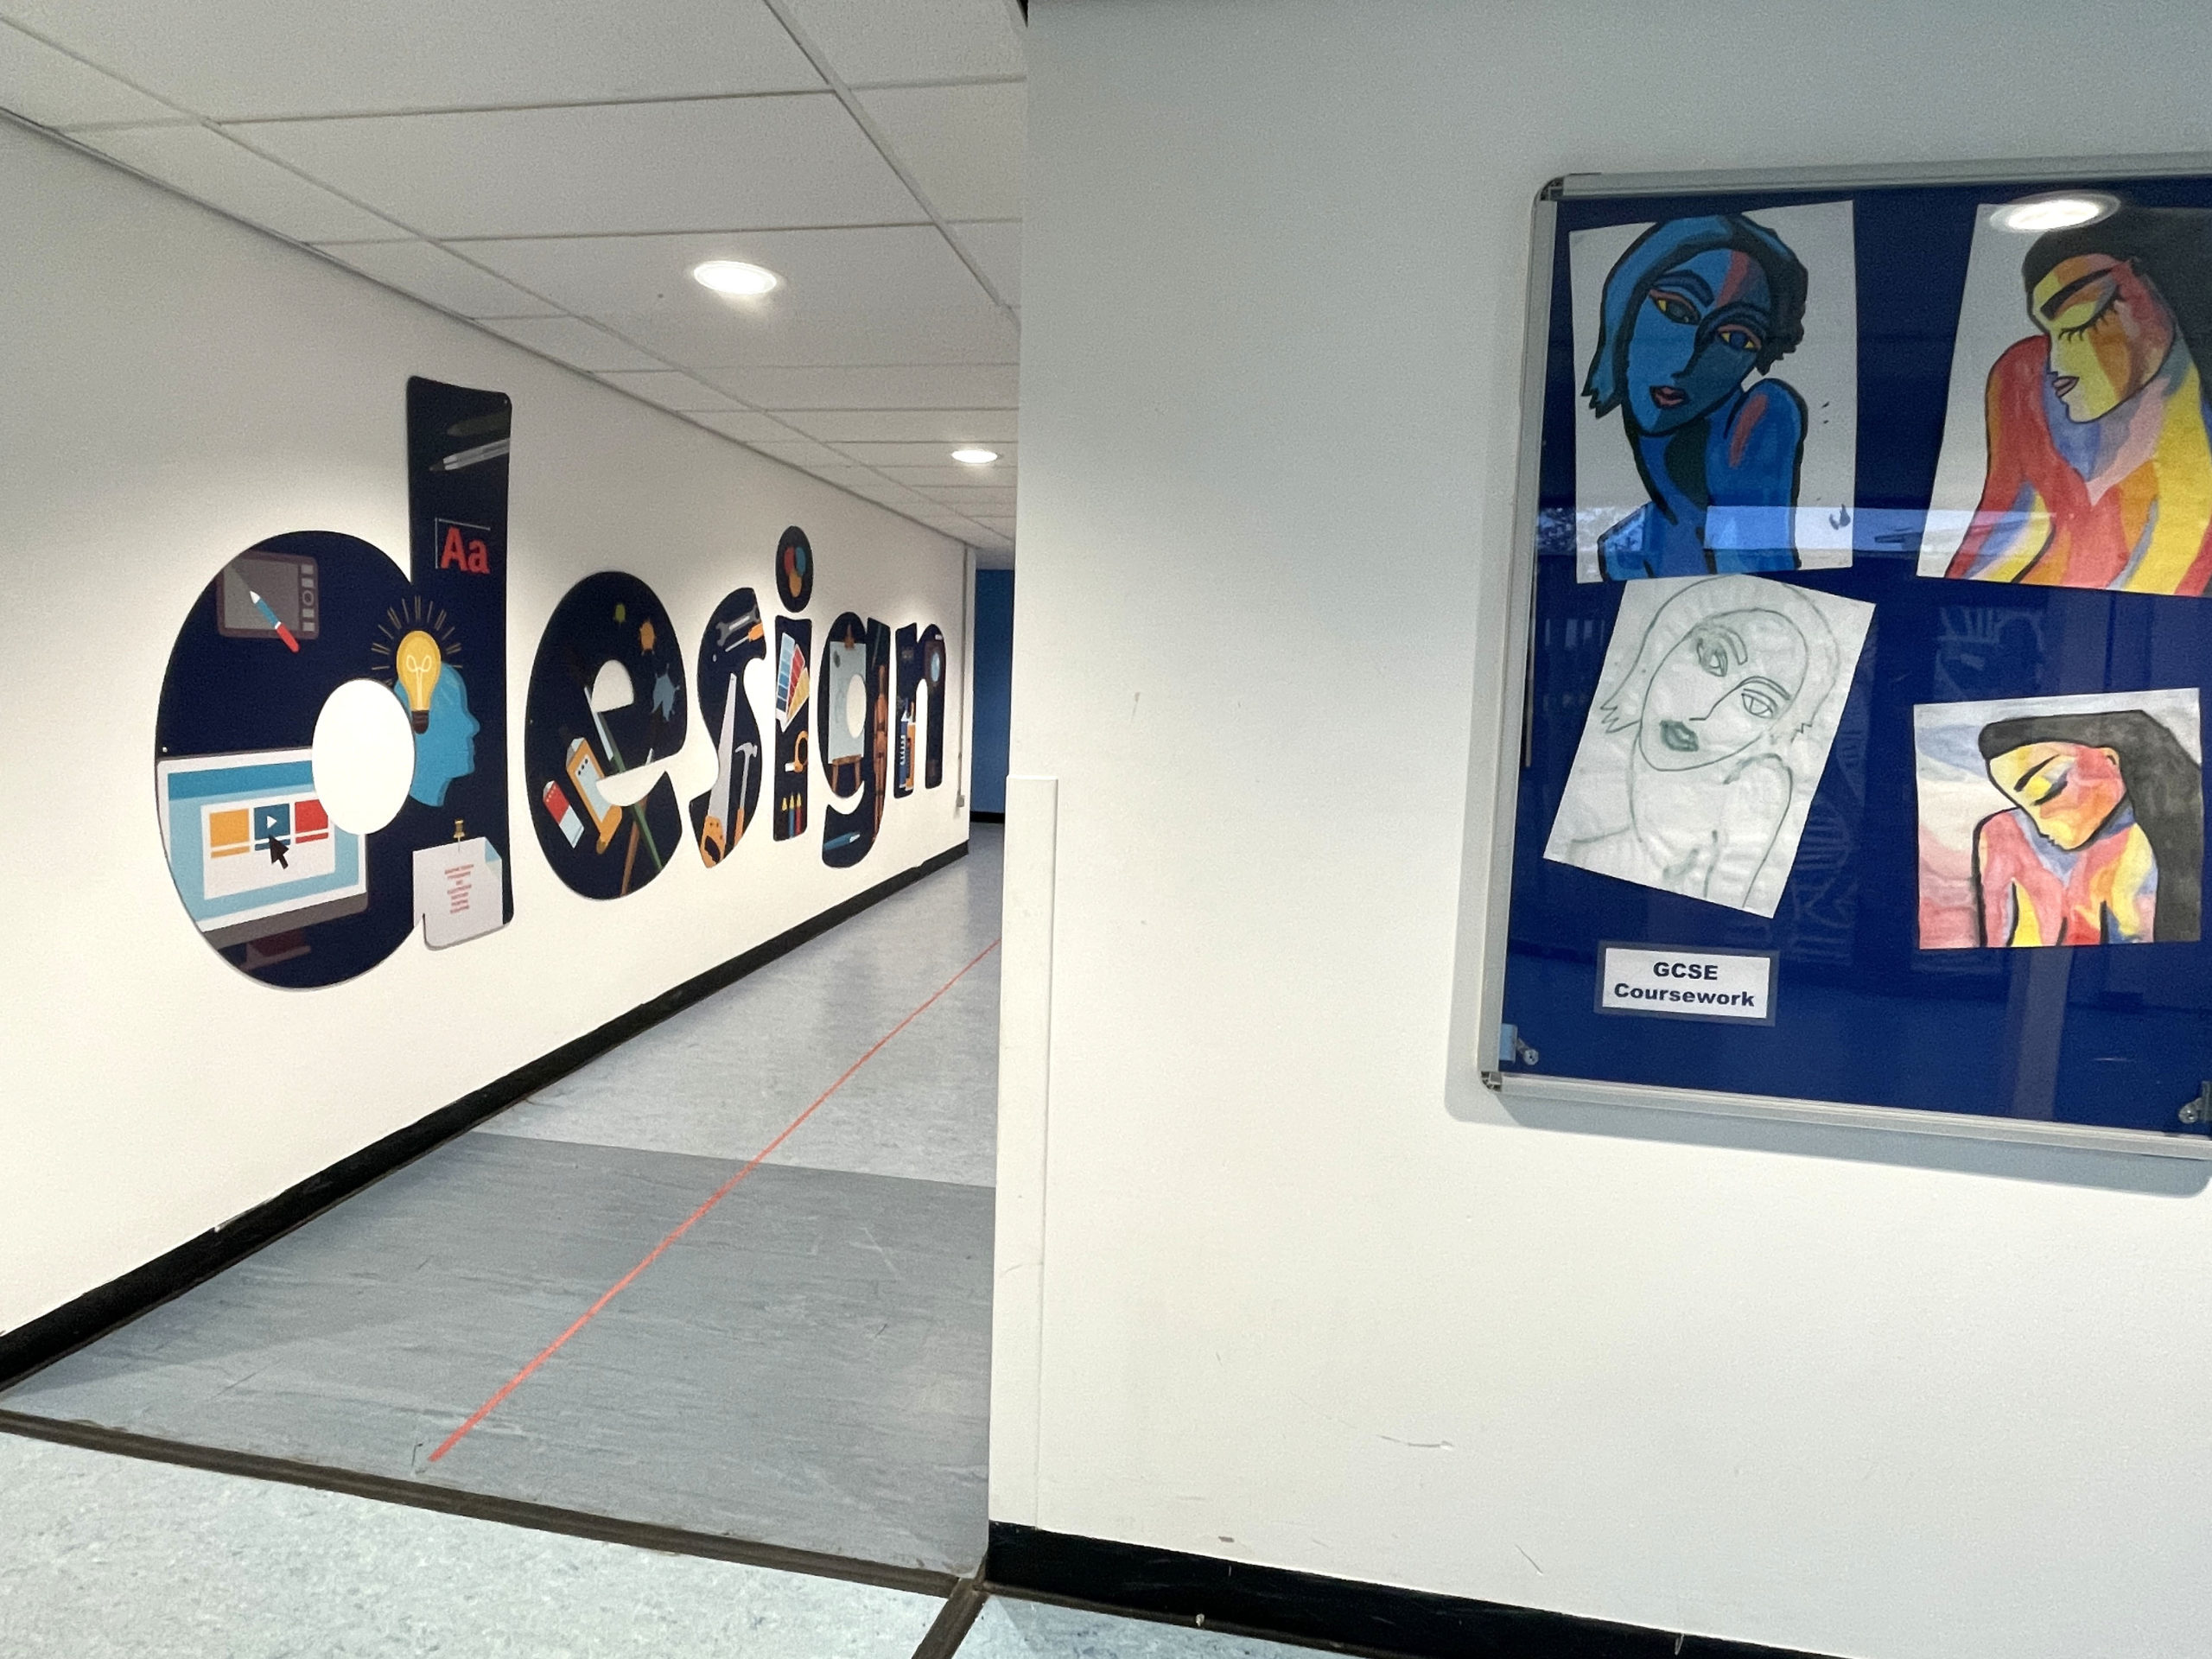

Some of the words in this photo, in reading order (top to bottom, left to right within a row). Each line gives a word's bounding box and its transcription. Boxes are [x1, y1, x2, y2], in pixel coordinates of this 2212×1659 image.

[441, 526, 491, 575] Aa
[156, 375, 946, 990] design
[1653, 961, 1719, 981] GCSE
[1613, 982, 1755, 1007] Coursework
